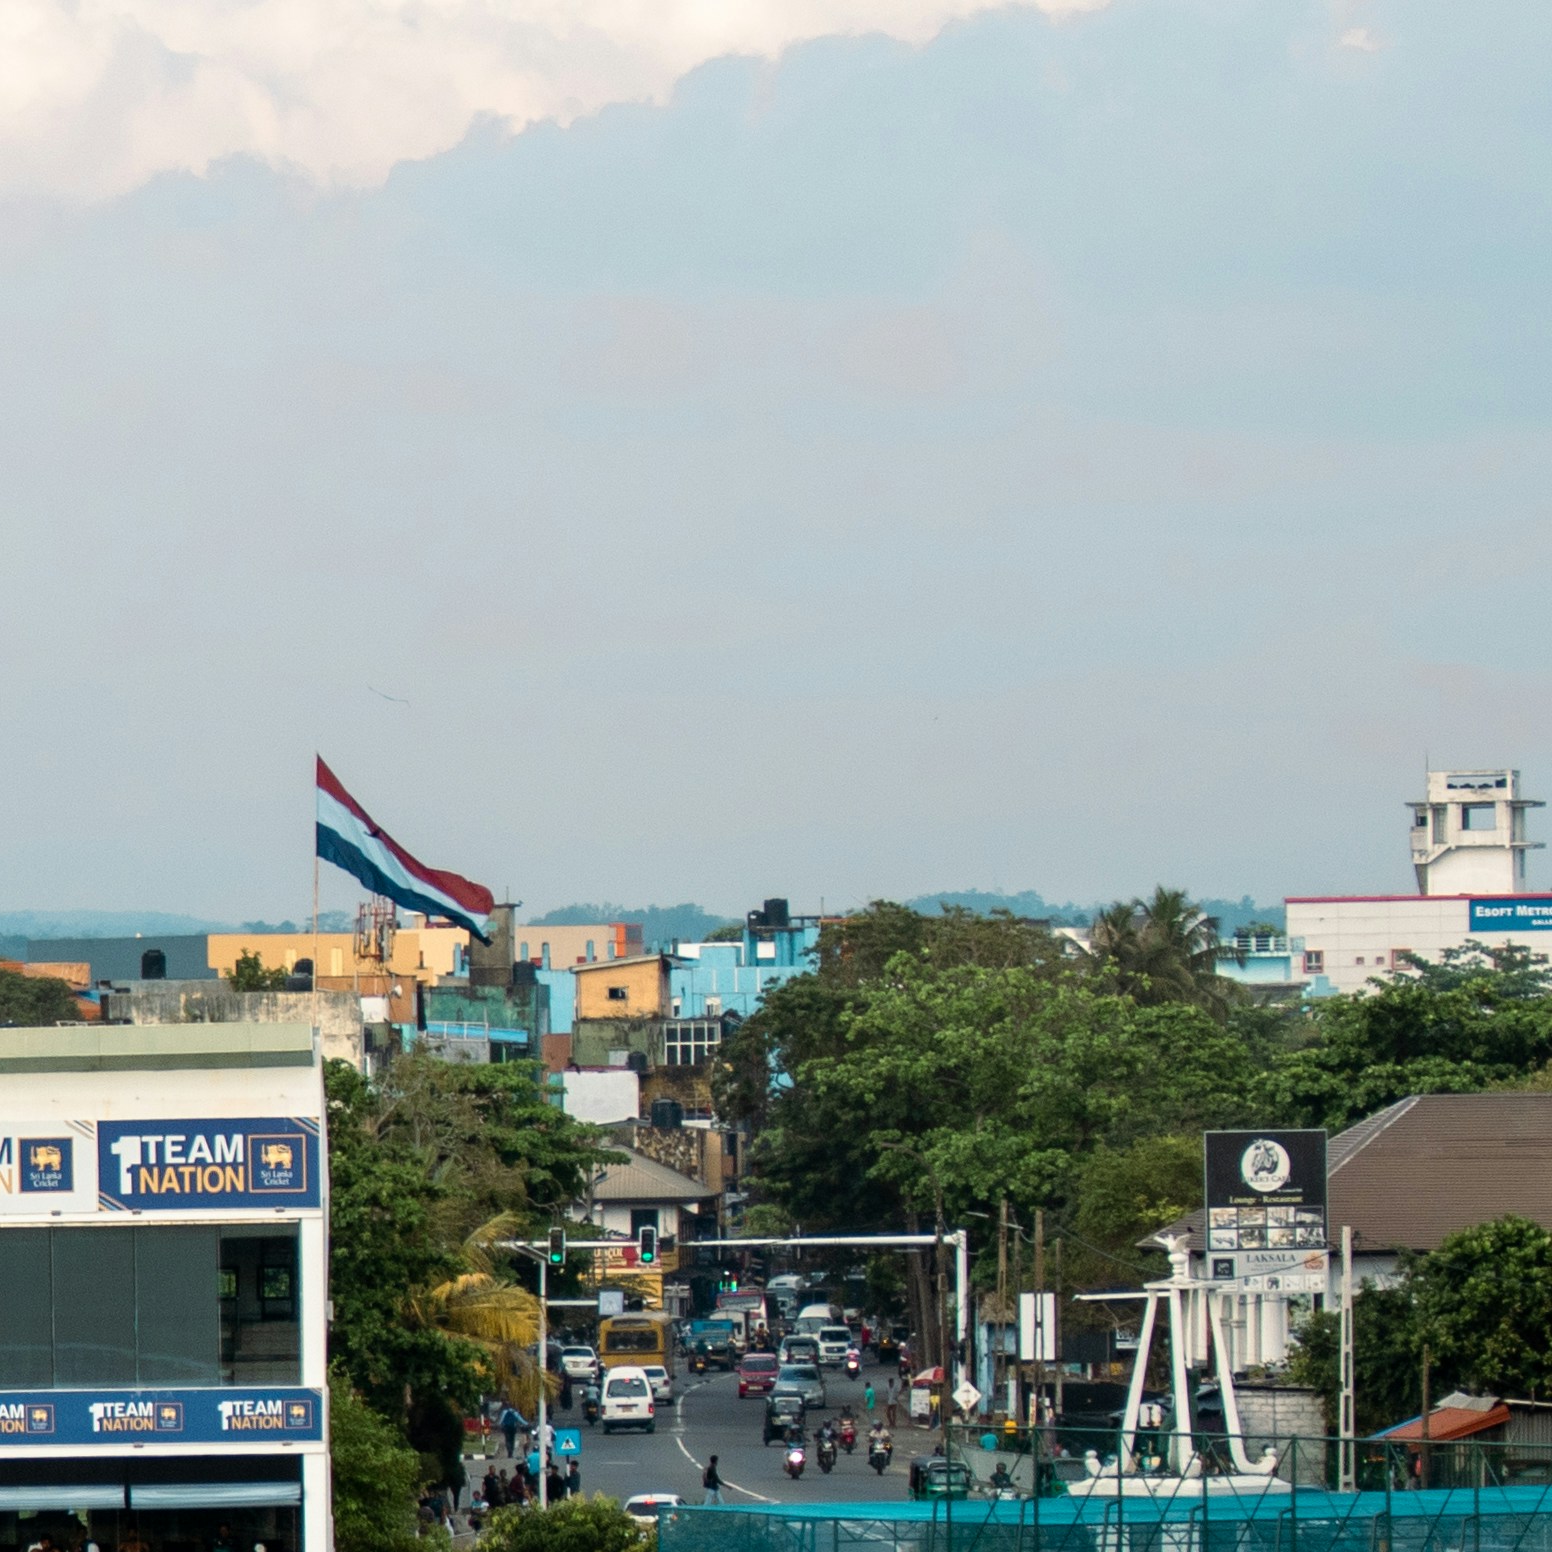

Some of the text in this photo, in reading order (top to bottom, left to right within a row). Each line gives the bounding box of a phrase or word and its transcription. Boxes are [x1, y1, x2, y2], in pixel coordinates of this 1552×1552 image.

[29, 1171, 63, 1181] Sri Lanka
[260, 1169, 293, 1179] Sri Lanka
[32, 1179, 59, 1188] Cricket
[139, 1165, 245, 1194] NATION
[263, 1177, 290, 1186] Cricket
[1246, 1254, 1296, 1263] LAKSALA
[103, 1417, 154, 1431] NATION
[231, 1415, 282, 1430] NATION
